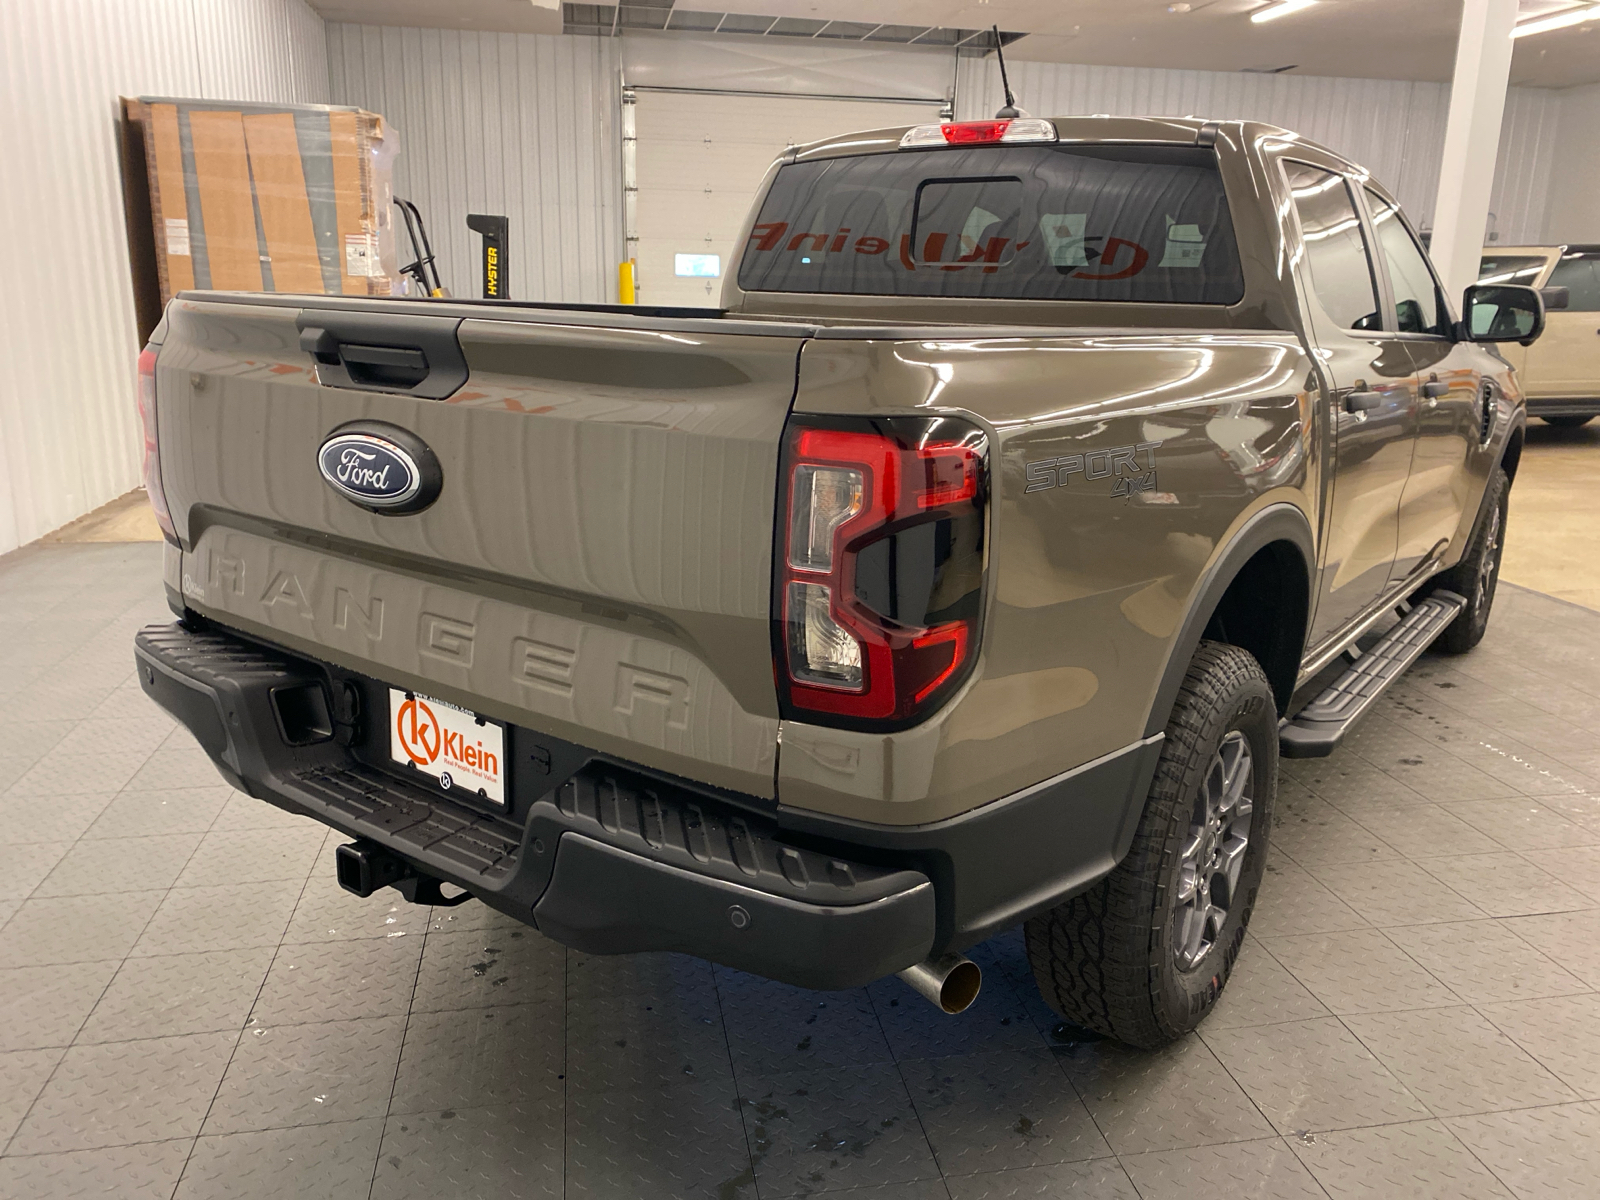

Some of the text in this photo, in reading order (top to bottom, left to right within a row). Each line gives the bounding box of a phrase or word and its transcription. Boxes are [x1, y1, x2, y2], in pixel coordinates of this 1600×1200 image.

[488, 247, 497, 295] HYSTER
[337, 448, 390, 489] Ford
[1024, 440, 1163, 494] SPORT
[208, 548, 690, 729] RANGER
[443, 728, 498, 775] Klein
[443, 757, 454, 767] Real
[472, 768, 482, 778] Real
